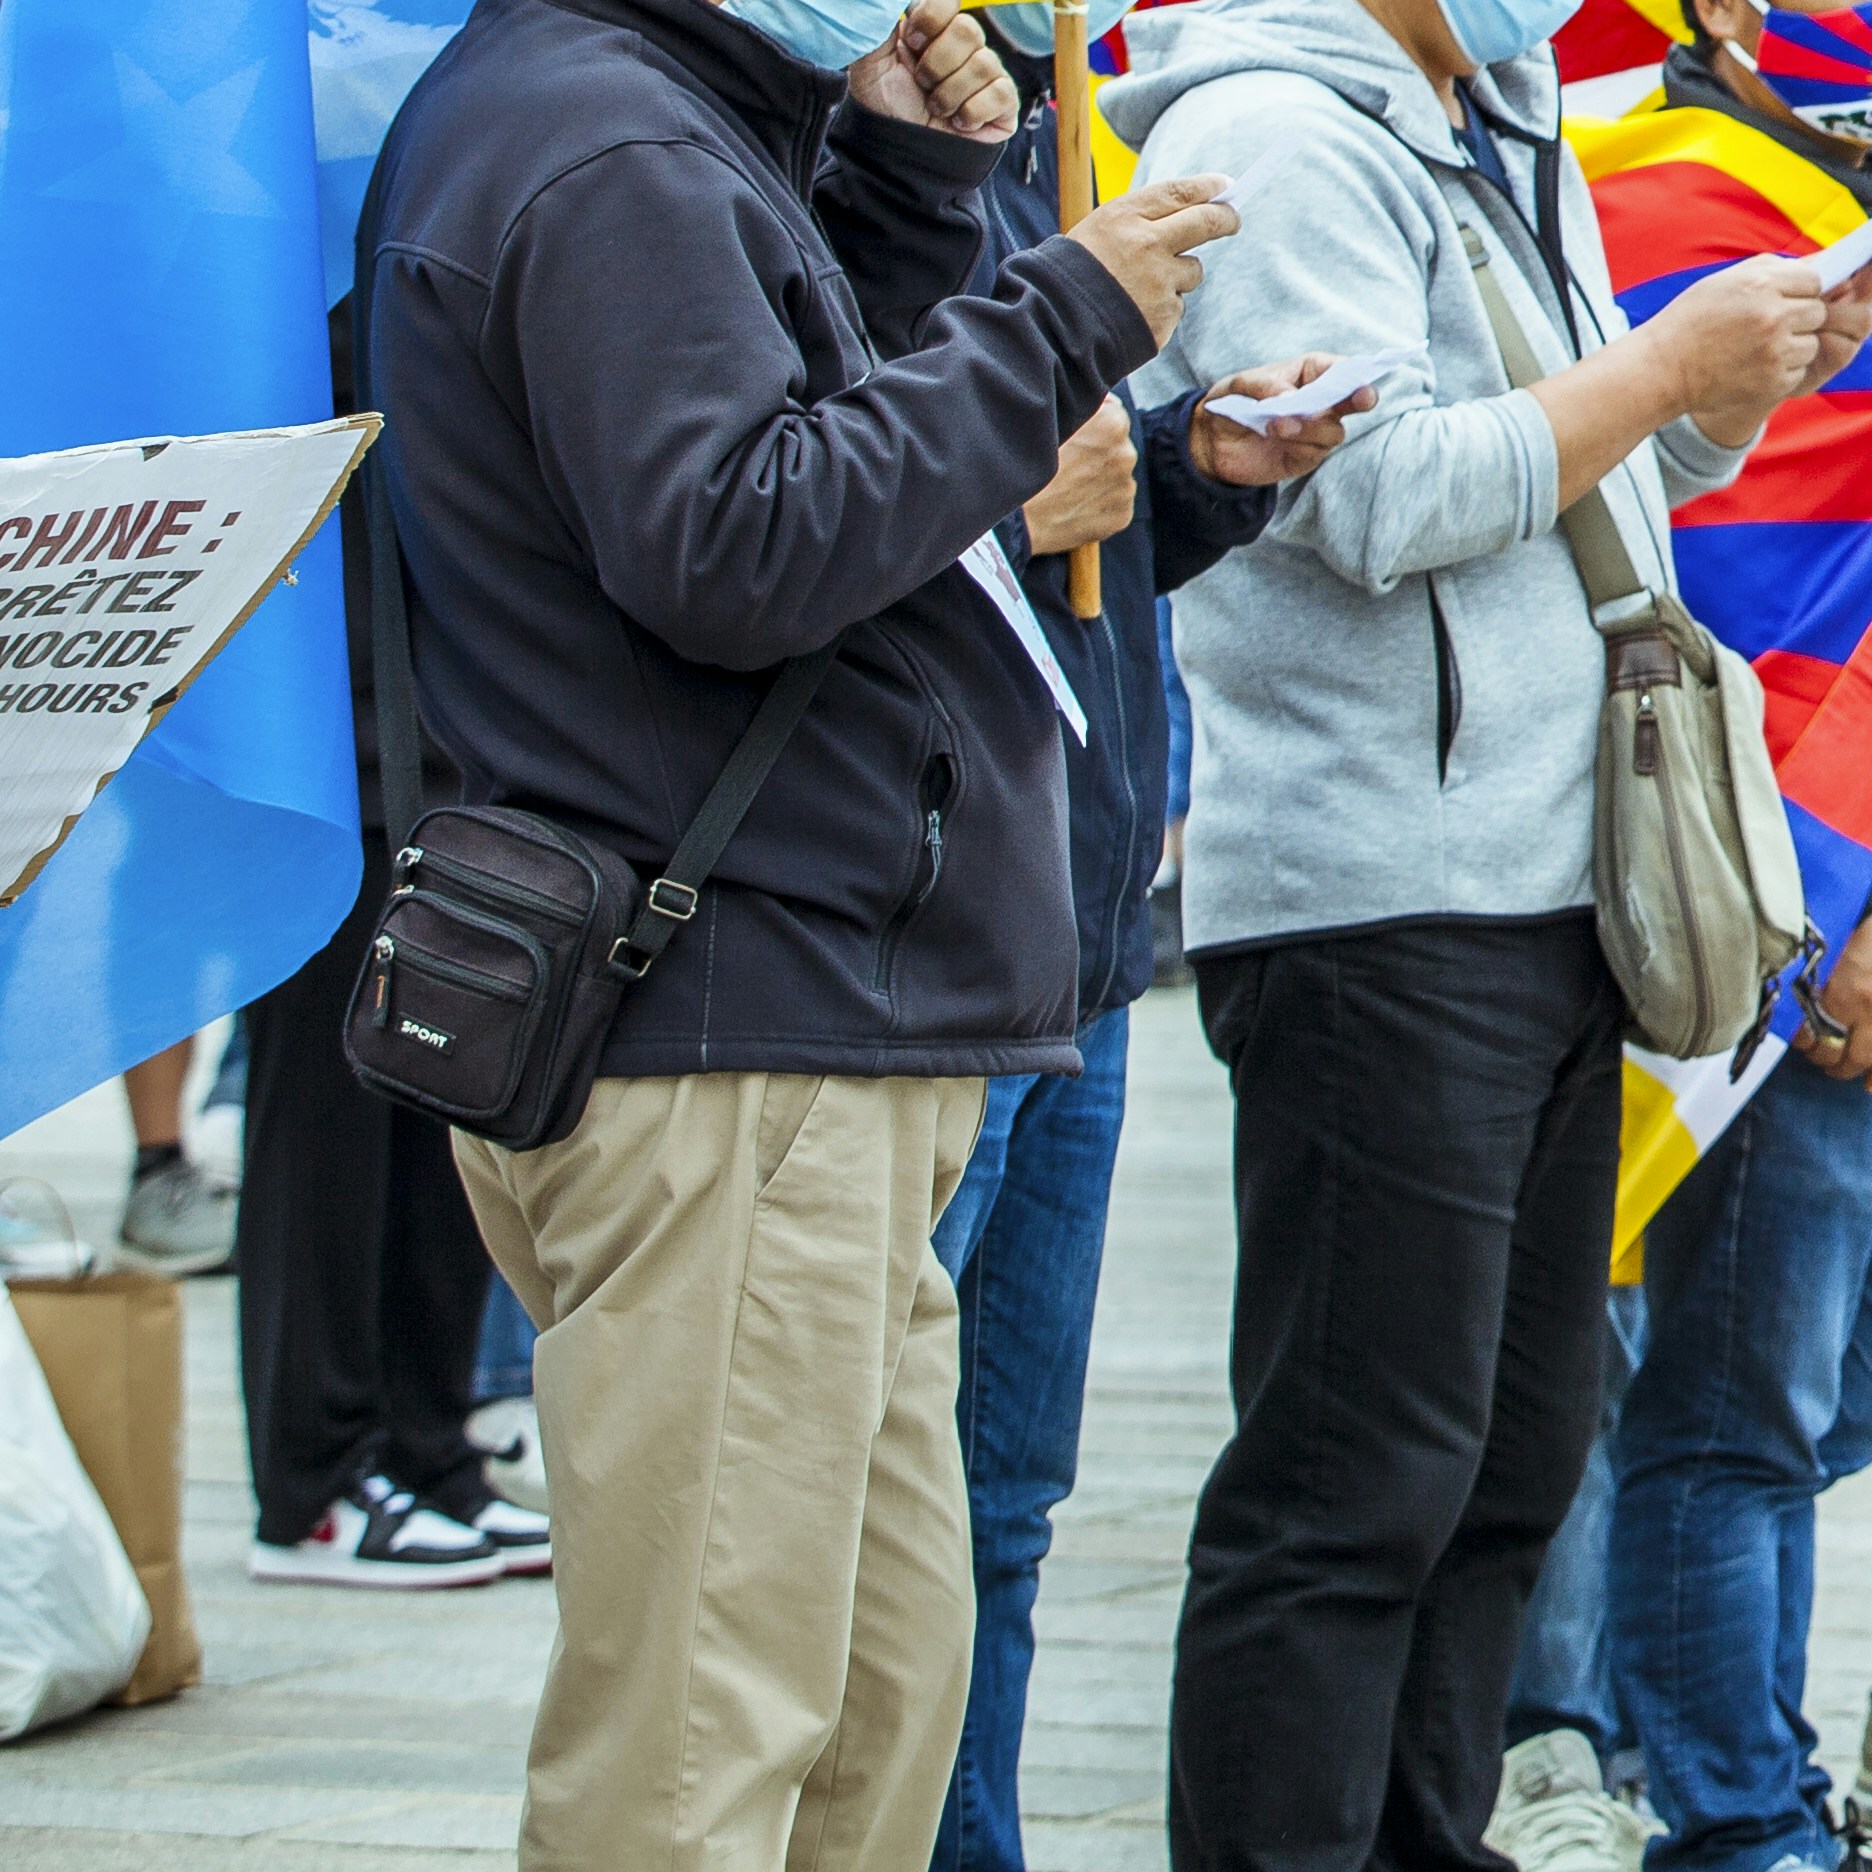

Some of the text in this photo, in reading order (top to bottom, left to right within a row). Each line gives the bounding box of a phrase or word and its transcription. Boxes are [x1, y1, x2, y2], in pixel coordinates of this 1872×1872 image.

[0, 499, 207, 572] CHINE
[0, 569, 205, 621] RÊTEZ
[401, 1020, 448, 1048] SPORT
